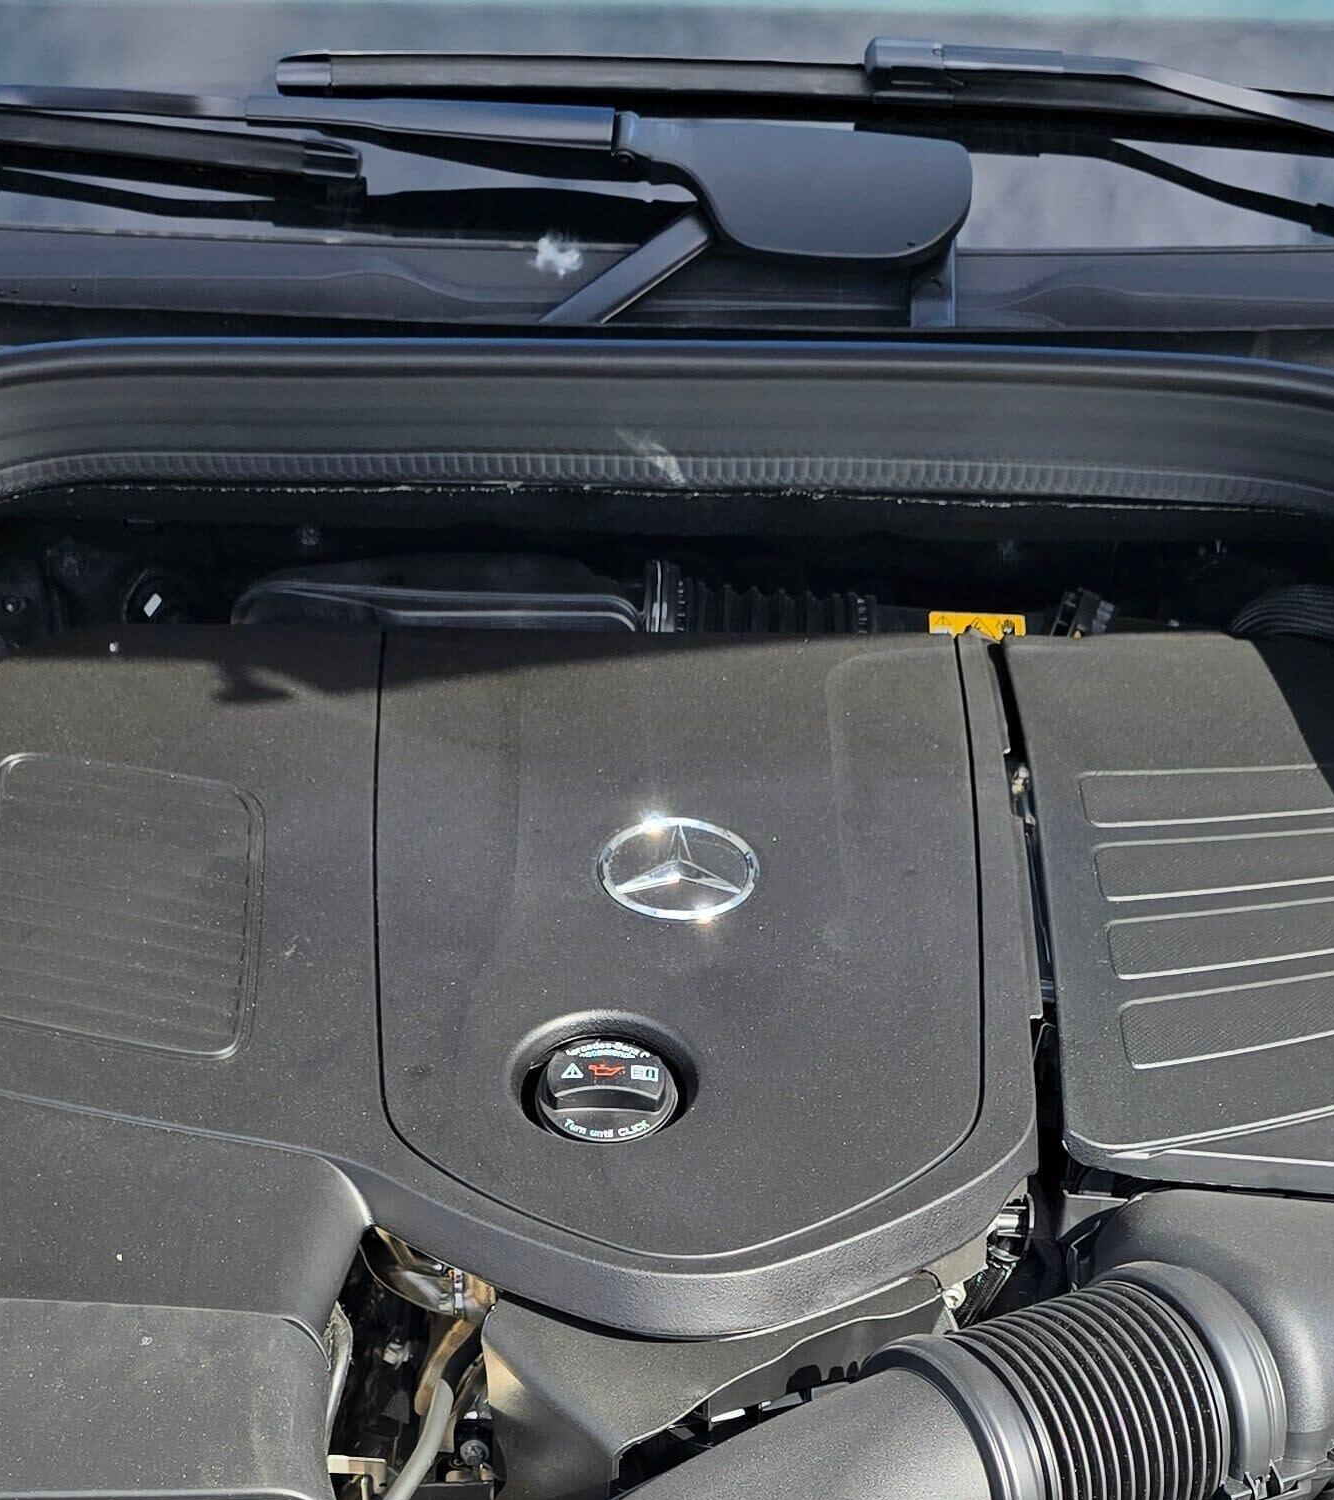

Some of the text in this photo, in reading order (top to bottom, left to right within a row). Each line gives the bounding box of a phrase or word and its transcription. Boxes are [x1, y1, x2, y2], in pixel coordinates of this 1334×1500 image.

[564, 1119, 650, 1138] Turn until CLICK
